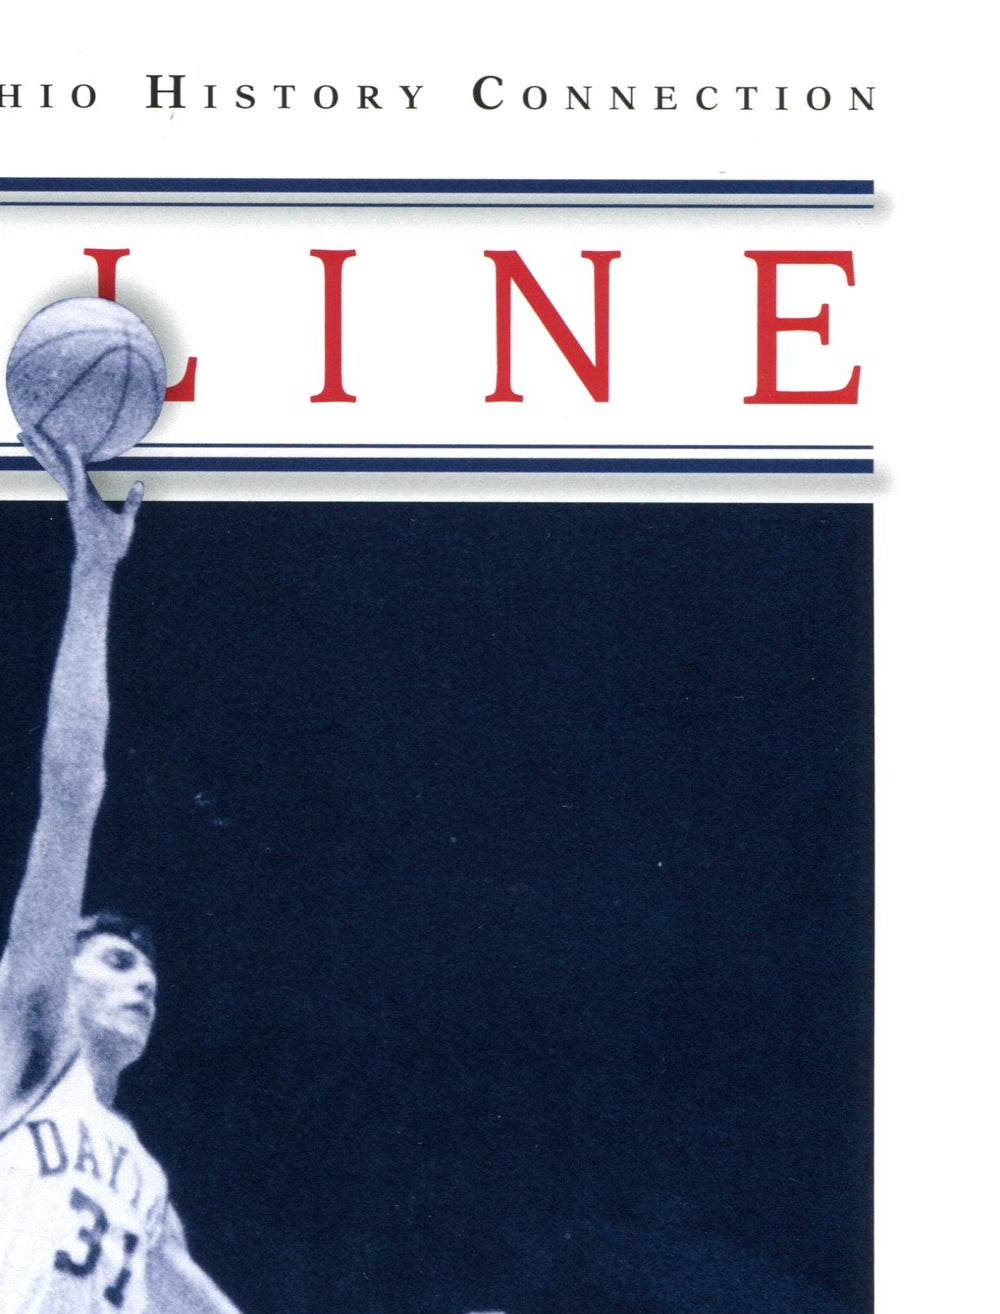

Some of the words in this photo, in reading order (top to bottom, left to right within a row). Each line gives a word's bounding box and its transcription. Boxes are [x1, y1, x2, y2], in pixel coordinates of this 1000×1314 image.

[144, 73, 425, 111] HISTORY
[471, 74, 876, 112] CONNECTION
[53, 1186, 140, 1310] 31
